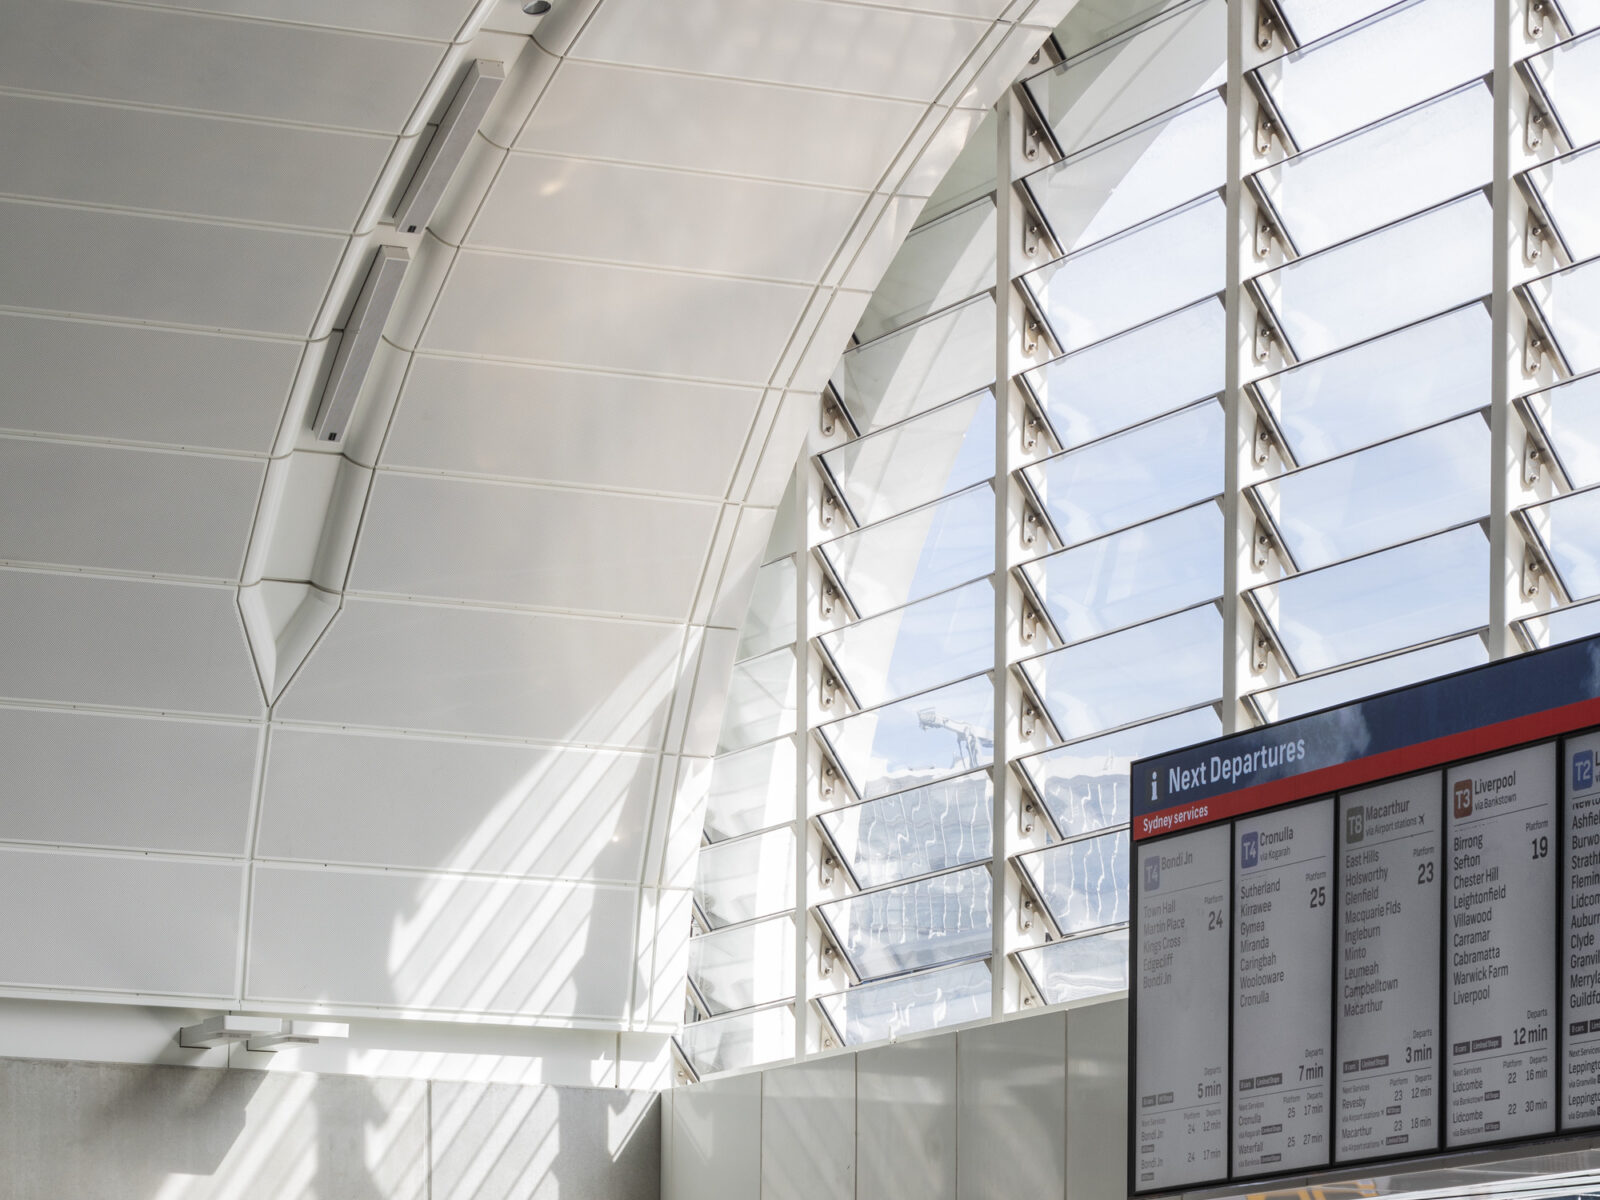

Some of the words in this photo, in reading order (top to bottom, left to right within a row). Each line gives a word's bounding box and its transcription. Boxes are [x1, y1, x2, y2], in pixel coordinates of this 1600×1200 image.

[1169, 762, 1207, 794] Next
[1210, 739, 1305, 784] Departures
[1575, 759, 1591, 782] T2
[1475, 770, 1516, 795] Liverpool
[1455, 788, 1471, 810] T3
[1475, 801, 1483, 811] via
[1484, 793, 1517, 809] Bankstown
[1143, 814, 1173, 834] Sydney
[1174, 805, 1208, 825] services
[1365, 800, 1410, 821] Macarthur
[1348, 814, 1363, 836] T8
[1366, 827, 1374, 837] via
[1375, 822, 1394, 835] Airport
[1394, 816, 1417, 829] stations
[1526, 820, 1548, 832] Platform
[1260, 826, 1294, 847] Cronulla
[1454, 834, 1483, 852] Birrong
[1572, 833, 1600, 850] Burwo
[1243, 841, 1257, 861] T4
[1269, 846, 1291, 860] Kogarah
[1413, 846, 1435, 857] Platform
[1531, 836, 1548, 860] 19
[1161, 852, 1183, 871] Bondi
[1184, 851, 1193, 866] Jn
[1346, 854, 1362, 869] East
[1363, 849, 1379, 864] Hills
[1454, 854, 1481, 871] Sefton
[1145, 864, 1159, 885] T4
[1305, 871, 1326, 882] Platform
[1345, 866, 1389, 888] Holsworthy
[1417, 861, 1434, 885] 23
[1454, 873, 1484, 890] Chester
[1485, 866, 1499, 882] Hill
[1571, 871, 1600, 889] Flemin
[1240, 878, 1280, 899] Sutherland
[1310, 886, 1326, 909] 25
[1345, 885, 1379, 906] Glenfield
[1454, 884, 1506, 910] Leightonfield
[1144, 905, 1162, 919] Town
[1162, 900, 1176, 915] Hall
[1240, 901, 1272, 918] Kirrawee
[1345, 904, 1385, 924] Macquarie
[1386, 899, 1402, 916] Flds
[1453, 907, 1492, 928] Villawood
[1144, 920, 1166, 936] Martin
[1167, 917, 1185, 931] Place
[1208, 909, 1224, 931] 24
[1240, 920, 1265, 937] Gymea
[1240, 935, 1270, 953] Miranda
[1344, 924, 1381, 945] Ingleburn
[1453, 930, 1491, 948] Carramar
[1571, 931, 1595, 951] Clyde
[1144, 939, 1162, 955] Kings
[1163, 935, 1181, 949] Cross
[1344, 947, 1367, 961] Minto
[1143, 953, 1174, 972] Edgecliff
[1240, 952, 1277, 972] Caringbah
[1453, 946, 1500, 967] Cabramatta
[1344, 960, 1379, 981] Leumeah
[1453, 966, 1487, 986] Warwick
[1488, 964, 1509, 980] Farm
[1143, 974, 1163, 989] Bondi
[1163, 974, 1172, 987] Jn
[1240, 971, 1285, 990] Woolooware
[1344, 978, 1399, 999] Campbelltown
[1240, 990, 1270, 1008] Cronulla
[1453, 984, 1490, 1006] Liverpool
[1343, 999, 1384, 1018] Macarthur
[1527, 1008, 1548, 1019] Departs
[1413, 1029, 1432, 1039] Departs
[1513, 1027, 1526, 1046] 12
[1528, 1024, 1548, 1044] min
[1305, 1048, 1324, 1058] Departs
[1405, 1046, 1412, 1063] 3
[1413, 1043, 1432, 1063] min
[1529, 1055, 1548, 1065] Departs
[1299, 1065, 1305, 1081] 7
[1306, 1062, 1324, 1081] min
[1508, 1072, 1517, 1084] 22
[1526, 1069, 1534, 1081] 16
[1535, 1067, 1548, 1080] min
[1197, 1083, 1204, 1099] 5
[1205, 1080, 1221, 1098] min
[1411, 1087, 1419, 1099] 12
[1420, 1085, 1432, 1098] min
[1453, 1078, 1483, 1093] Lidcombe
[1342, 1096, 1367, 1109] Revesby
[1394, 1090, 1403, 1102] 23
[1525, 1100, 1534, 1113] 30
[1535, 1098, 1548, 1111] min
[1287, 1107, 1296, 1118] 25
[1304, 1104, 1311, 1116] 17
[1312, 1103, 1323, 1114] min
[1453, 1109, 1483, 1124] Lidcombe
[1508, 1103, 1517, 1115] 22
[1187, 1123, 1195, 1135] 24
[1203, 1121, 1210, 1132] 12
[1211, 1119, 1221, 1131] min
[1342, 1125, 1373, 1139] Macarthur
[1394, 1120, 1403, 1132] 23
[1411, 1118, 1419, 1129] 18
[1420, 1116, 1432, 1128] min
[1239, 1141, 1264, 1155] Waterfall
[1287, 1136, 1296, 1148] 25
[1303, 1134, 1311, 1146] 27
[1312, 1132, 1323, 1144] min
[1187, 1152, 1195, 1163] 24
[1203, 1149, 1210, 1161] 17
[1210, 1148, 1221, 1160] min
